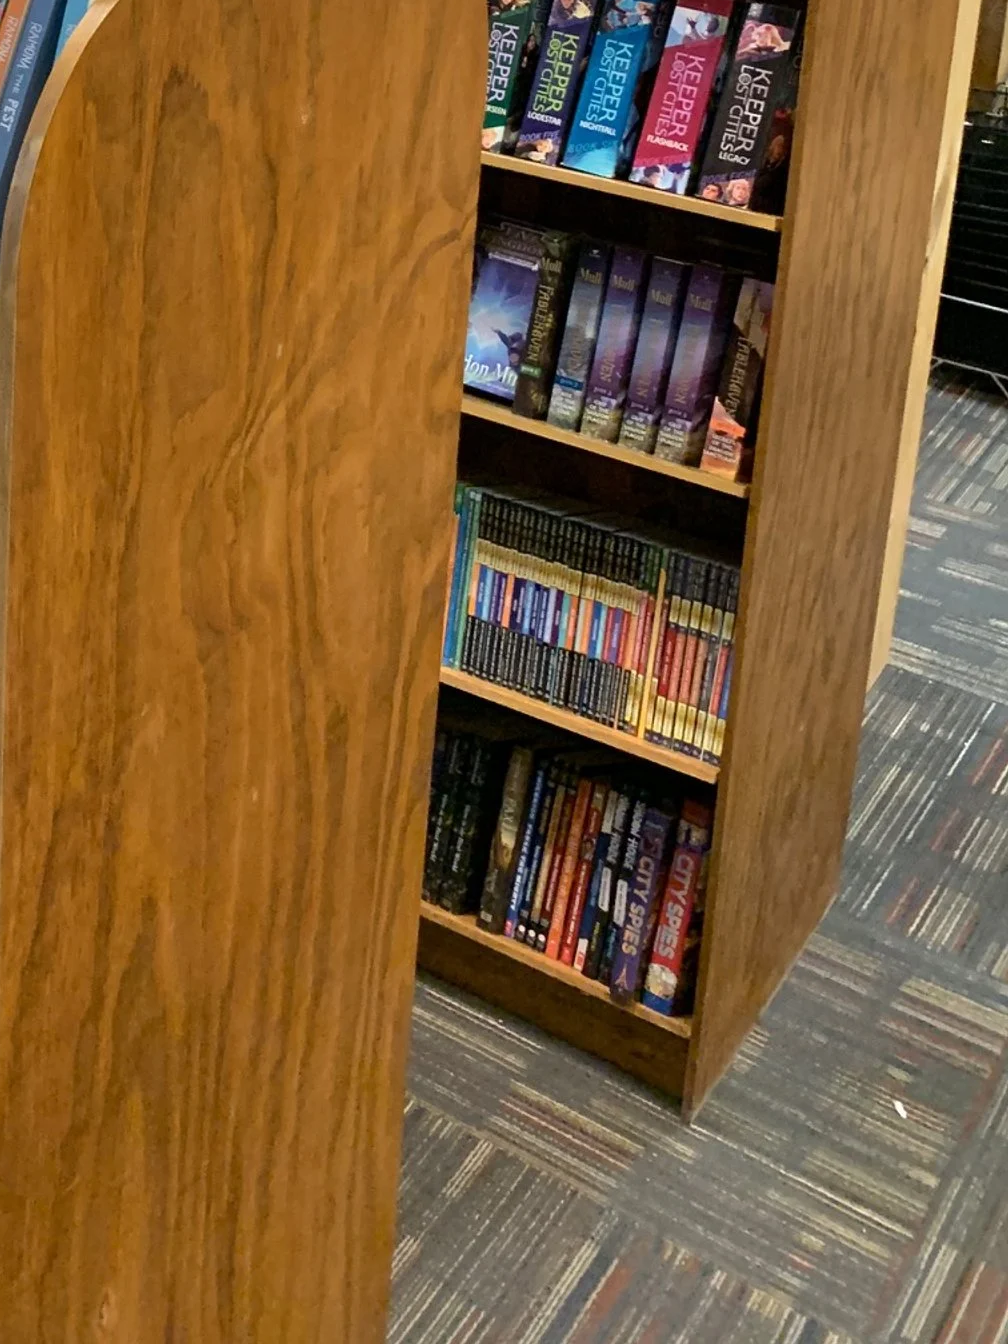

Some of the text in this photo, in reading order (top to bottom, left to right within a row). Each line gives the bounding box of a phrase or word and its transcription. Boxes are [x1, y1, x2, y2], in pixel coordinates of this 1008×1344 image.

[17, 21, 43, 68] RAMONA
[487, 24, 520, 103] KEEPER
[532, 29, 580, 113] KEEPER LOST CITIES
[585, 38, 635, 123] KEEPER LOST CITIES
[654, 51, 706, 138] KEEPER LOST CITIES
[0, 97, 19, 132] PEST
[526, 110, 562, 127] LODESTAR
[579, 119, 616, 137] NIGHTFALL
[719, 64, 774, 153] KEEPER LOST CITIES
[646, 134, 689, 152] FLASHBACK
[718, 150, 751, 166] LEGACY
[580, 267, 603, 284] Mull
[610, 274, 636, 291] Mull
[621, 856, 655, 956] CITY SPIES
[659, 853, 695, 960] CITY SPIES
